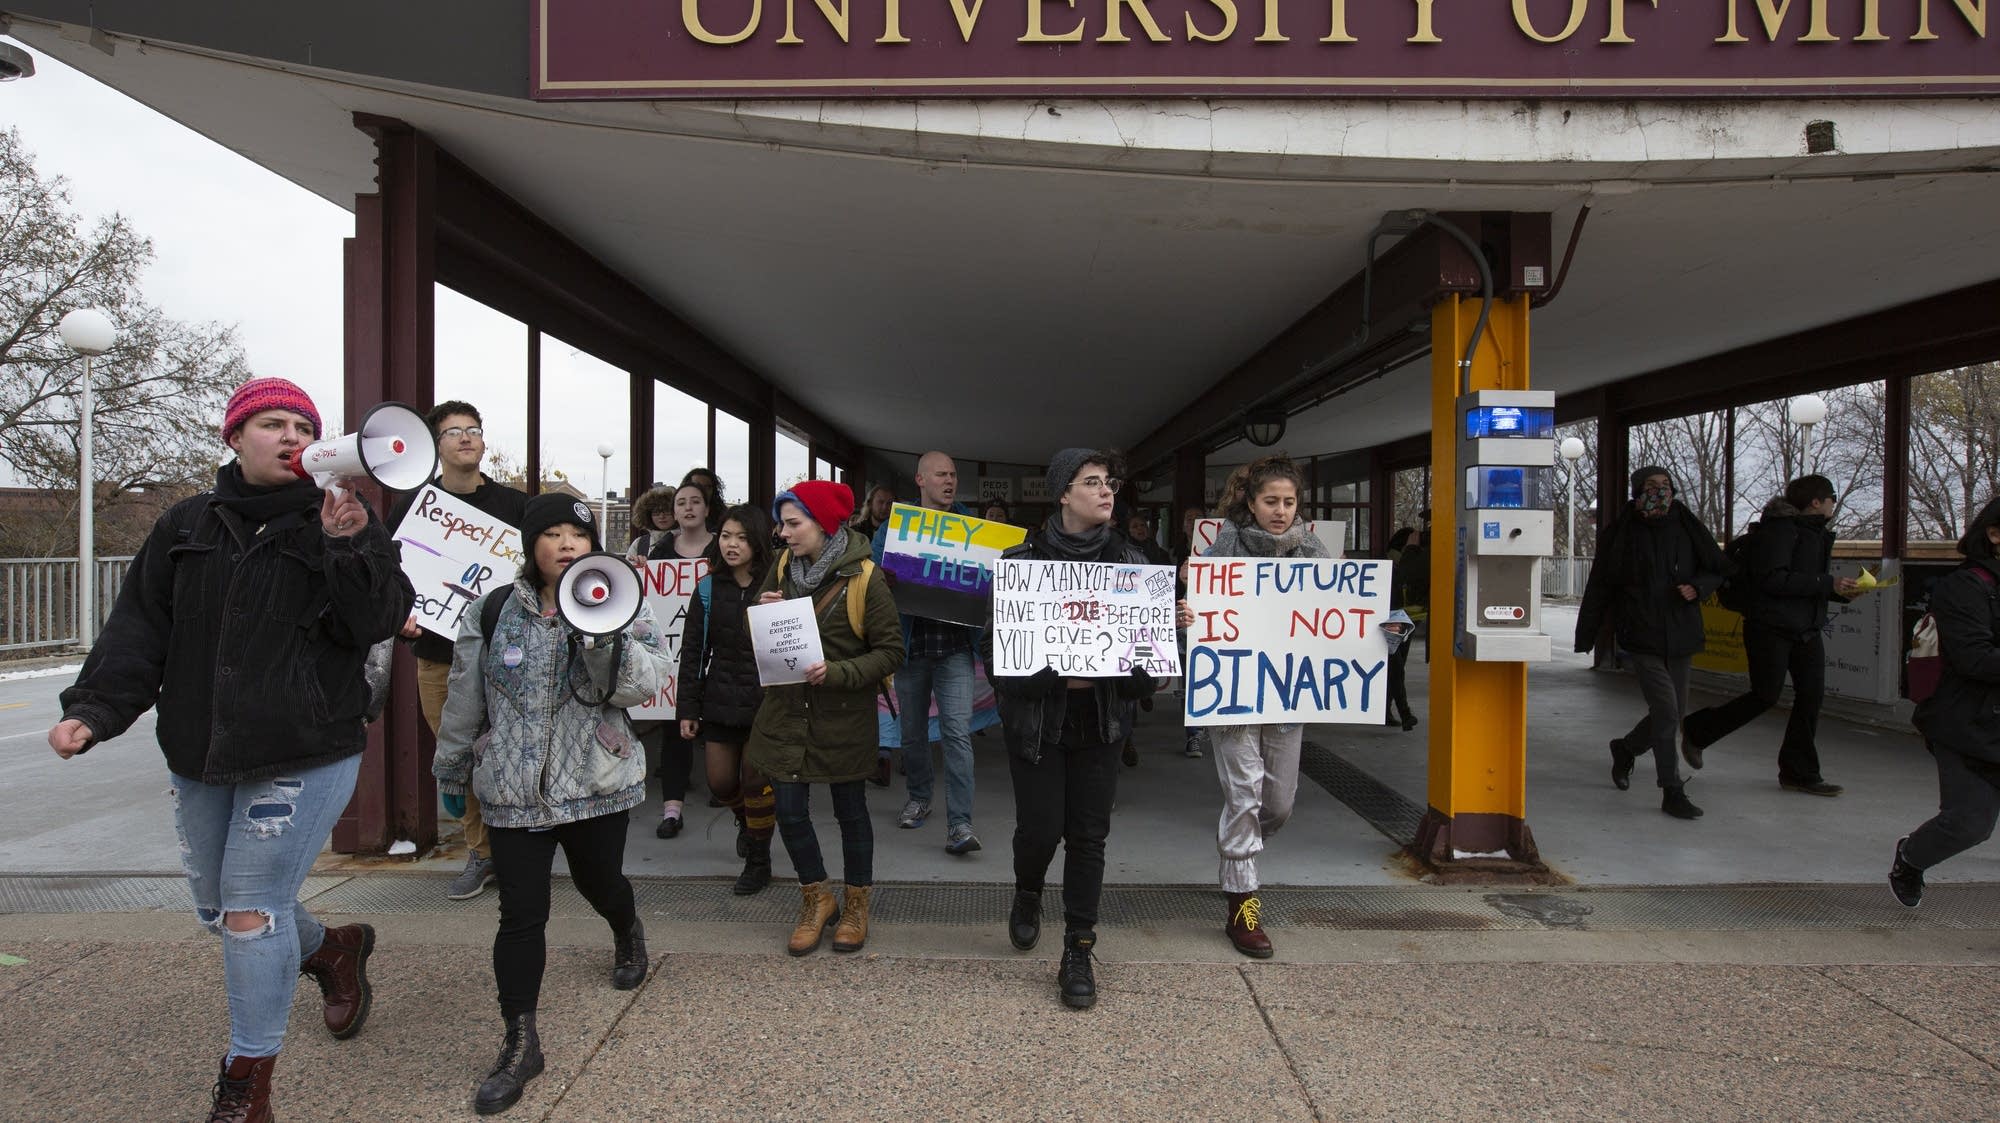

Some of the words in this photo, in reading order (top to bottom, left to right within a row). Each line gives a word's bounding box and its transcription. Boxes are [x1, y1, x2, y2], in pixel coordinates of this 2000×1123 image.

[415, 489, 494, 546] Respect
[894, 507, 984, 552] THEY
[461, 563, 492, 595] OR
[919, 552, 995, 590] THEM
[996, 561, 1033, 592] HOW
[1116, 569, 1138, 592] US
[1189, 562, 1246, 597] THE
[1255, 561, 1379, 598] FUTURE
[413, 593, 452, 621] ect
[996, 598, 1036, 624] HAVE
[1039, 602, 1062, 621] TO
[1067, 600, 1101, 621] DIE
[1107, 603, 1172, 625] BEFORE
[769, 623, 803, 635] EXISTENCE
[771, 617, 800, 628] RESPECT
[1117, 626, 1174, 643] SILENCE
[1197, 608, 1240, 643] IS
[1289, 607, 1376, 640] NOT
[769, 643, 809, 654] RESISTANCE
[776, 637, 801, 647] EXPECT
[996, 628, 1034, 671] YOU
[1044, 625, 1092, 645] GIVE
[1064, 645, 1072, 653] A
[1045, 653, 1098, 672] FUCK
[1118, 656, 1177, 674] DEATH
[1187, 645, 1386, 718] BINARY
